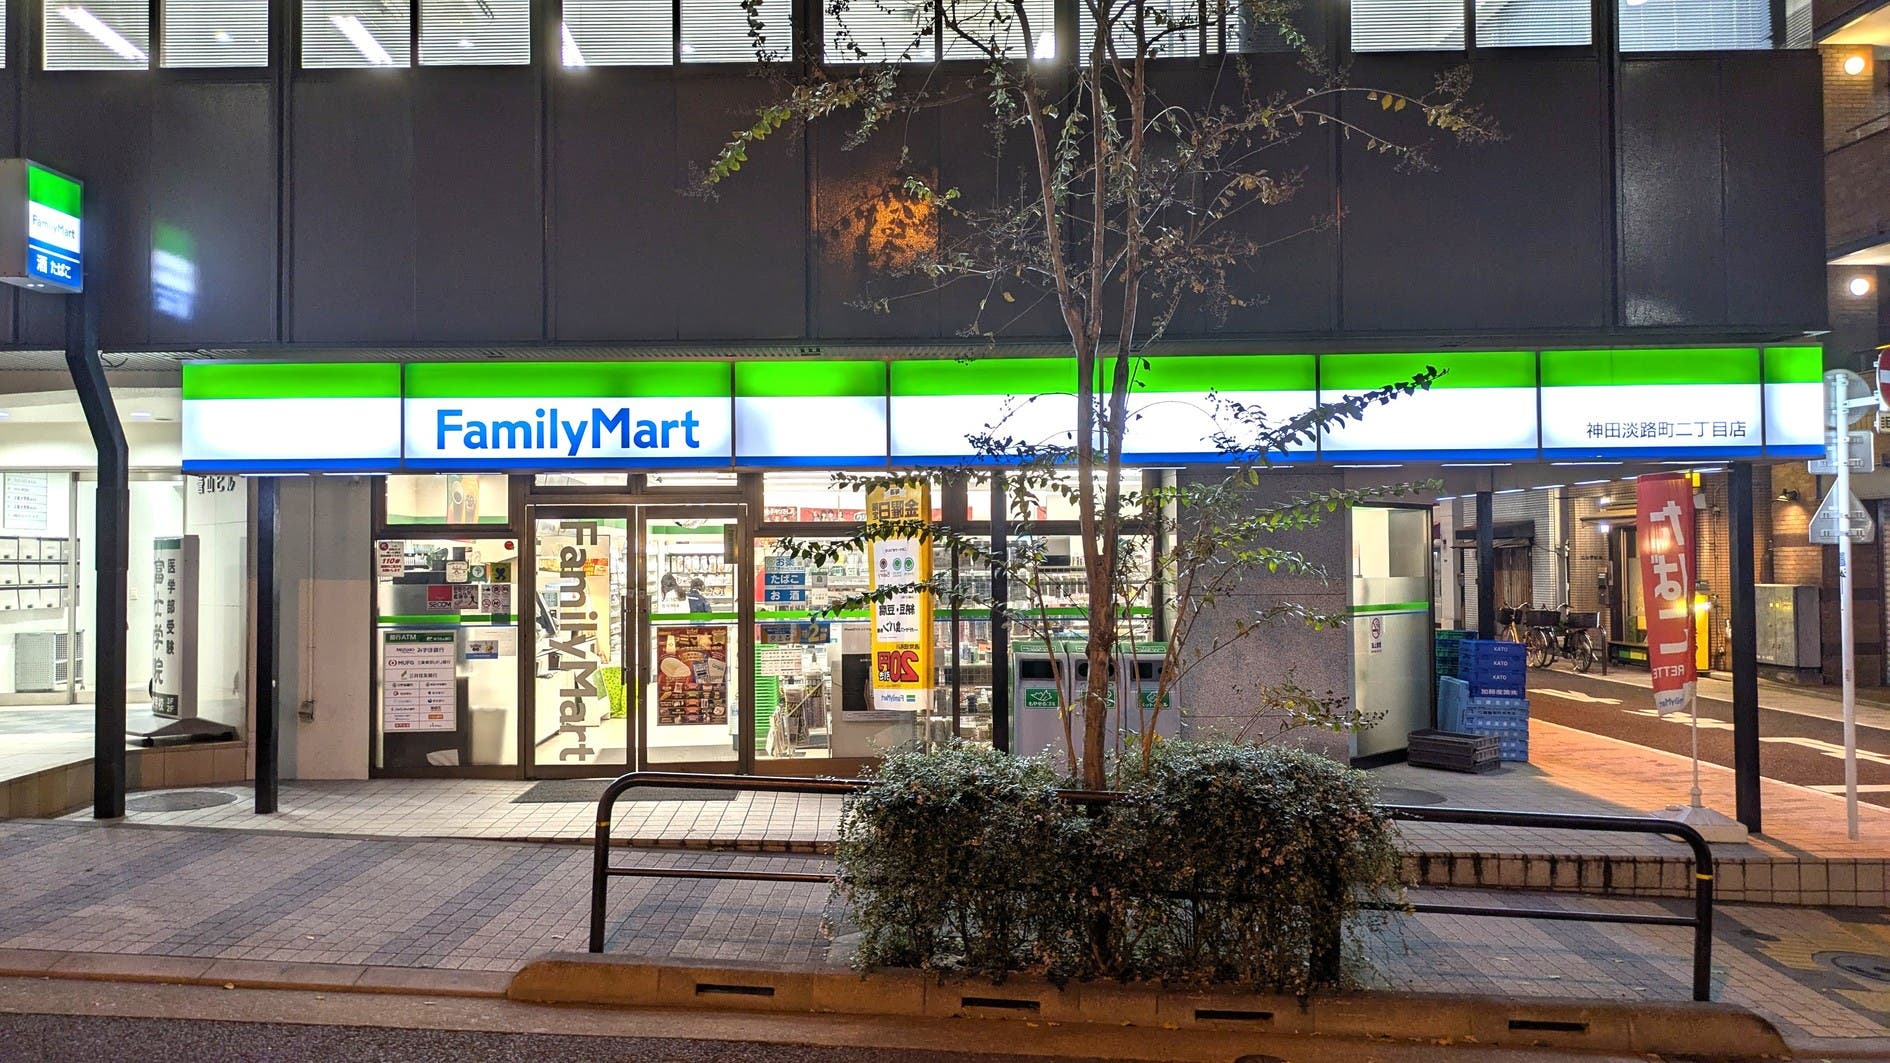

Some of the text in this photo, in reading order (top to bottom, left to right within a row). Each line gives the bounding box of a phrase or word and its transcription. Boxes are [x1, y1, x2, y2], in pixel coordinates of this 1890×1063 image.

[32, 214, 75, 239] FamilyMart
[50, 260, 71, 279] たばこ
[436, 407, 700, 456] FamilyMart
[1586, 421, 1747, 439] 神田淡路町二丁目店
[770, 574, 799, 584] たばこ
[166, 559, 176, 655] 医学部受験
[549, 521, 598, 762] FamilyMart
